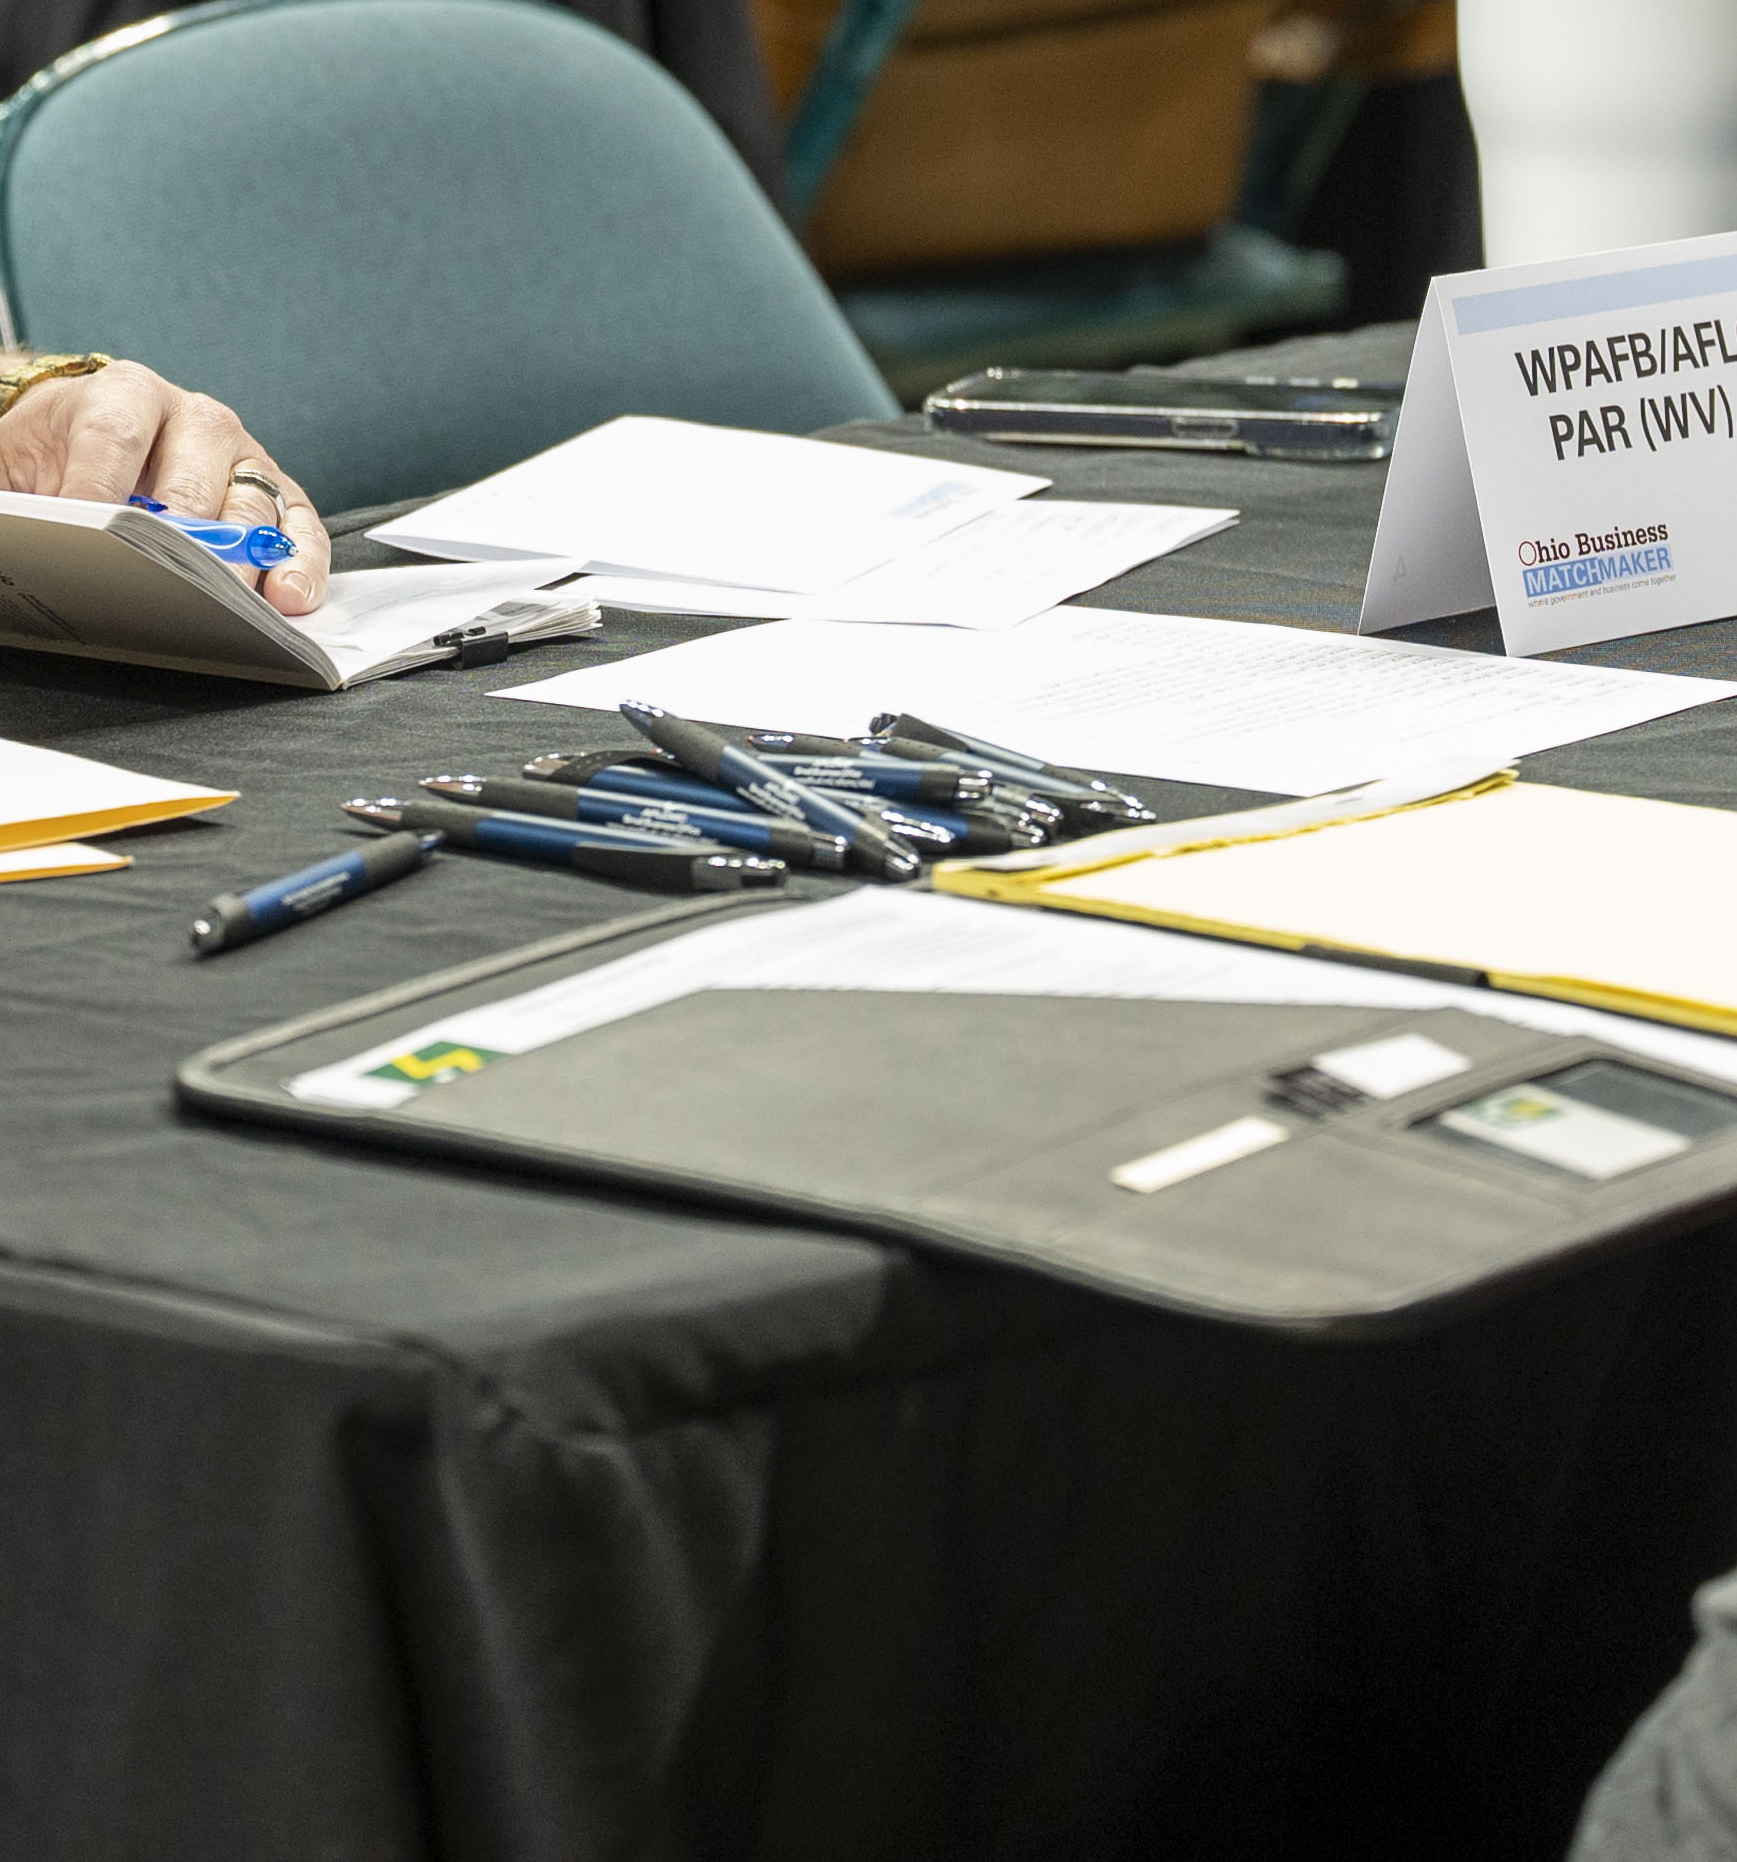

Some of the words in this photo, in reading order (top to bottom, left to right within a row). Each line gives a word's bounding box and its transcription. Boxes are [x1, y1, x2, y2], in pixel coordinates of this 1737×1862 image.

[1549, 404, 1633, 461] PAR
[1518, 538, 1571, 567] Ohio
[1574, 523, 1670, 556] Business
[1525, 547, 1672, 595] MATCHMAKER
[1527, 597, 1550, 609] where
[1550, 590, 1589, 607] government
[1589, 587, 1603, 597] and
[1603, 582, 1631, 595] business
[1631, 579, 1650, 590] come
